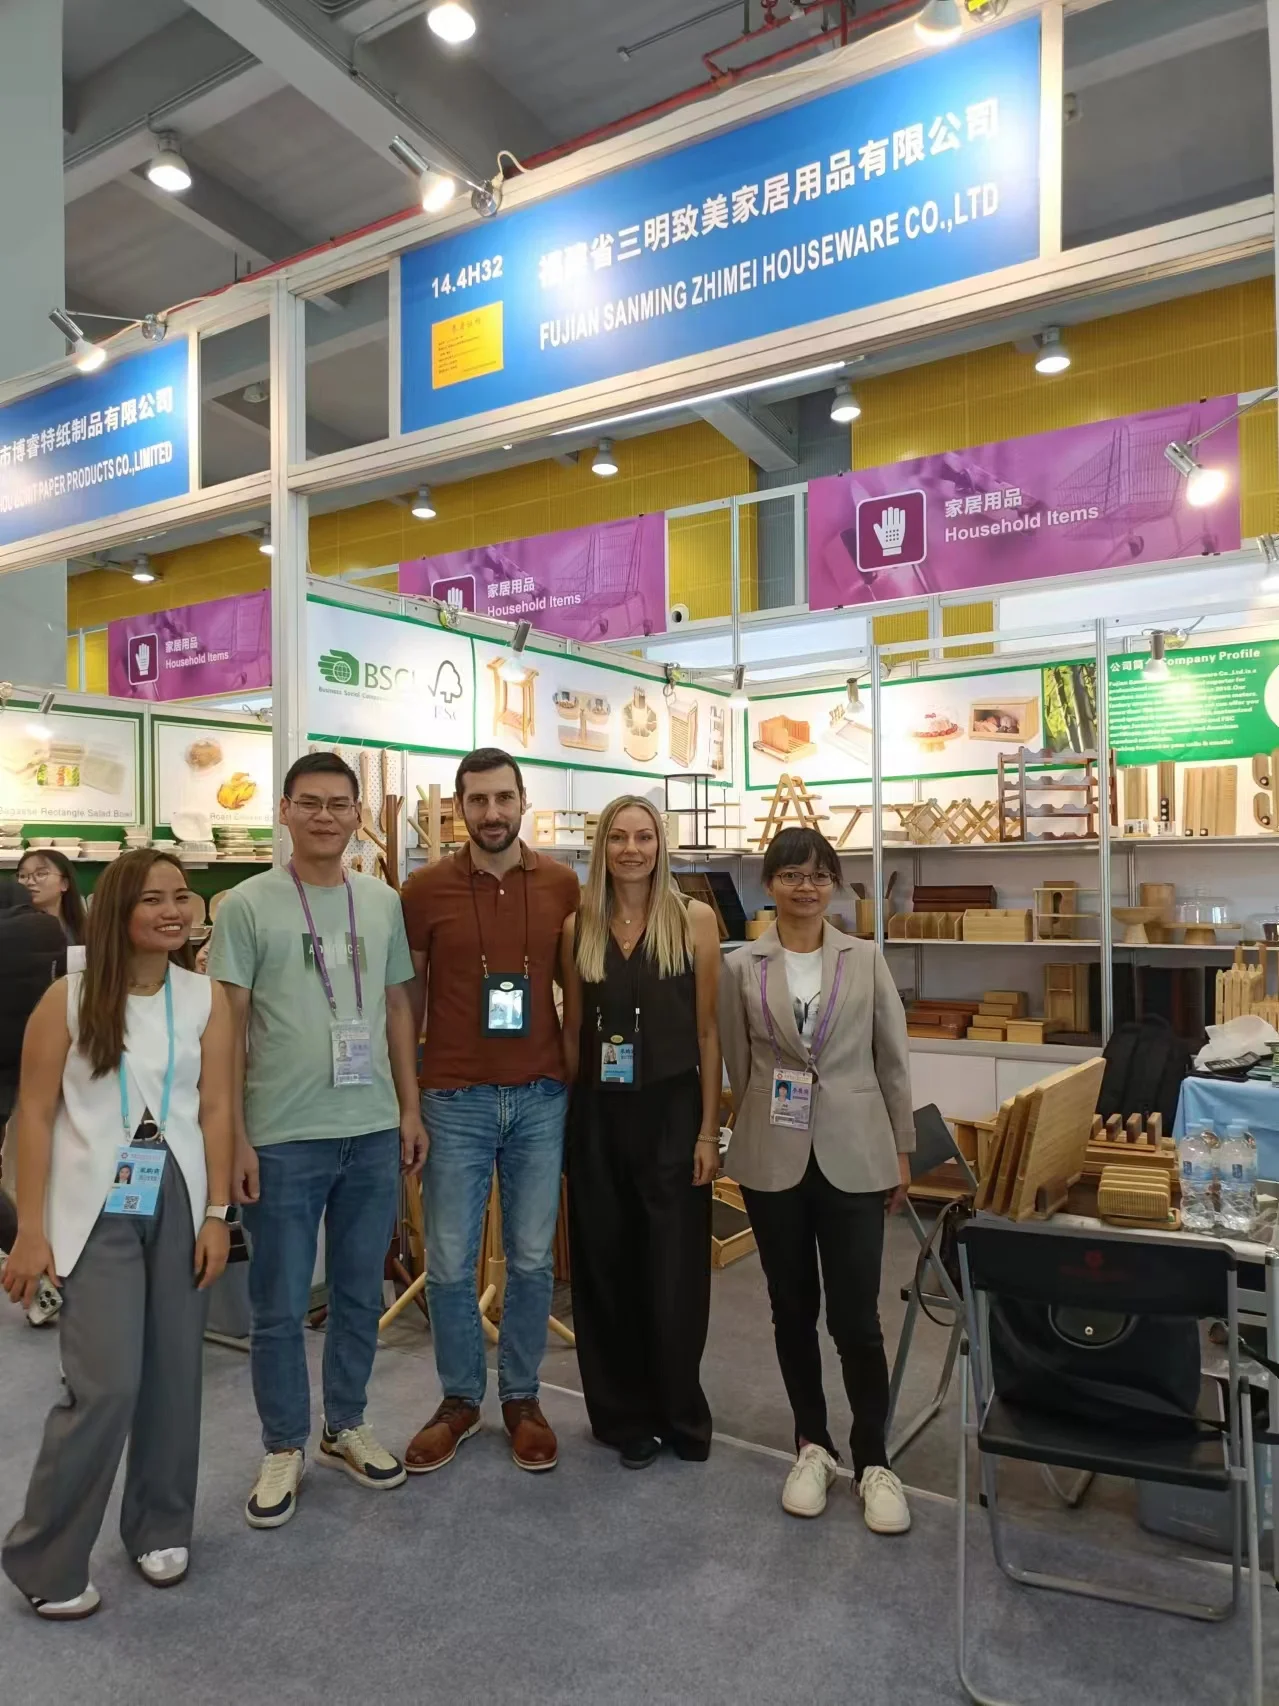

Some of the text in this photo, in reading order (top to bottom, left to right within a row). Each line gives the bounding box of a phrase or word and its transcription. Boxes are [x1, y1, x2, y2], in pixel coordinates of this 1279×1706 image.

[431, 254, 504, 298] 14.4H32
[539, 306, 599, 351] FUJIAN
[603, 280, 687, 331] SANMING
[691, 258, 757, 305] ZHIMEI
[763, 212, 899, 284] HOUSEWARE
[38, 474, 66, 501] PAPER
[66, 458, 114, 492] PRODUCTS
[944, 487, 1022, 518] 家居用品
[945, 506, 1099, 543] Household Items
[487, 576, 535, 598] 家居用品
[487, 594, 581, 617] Household Items
[165, 636, 198, 653] 家居用品
[1218, 649, 1261, 661] Profile
[165, 651, 229, 669] Household Items
[1109, 659, 1153, 672] 公司简
[318, 686, 342, 695] Business
[41, 807, 85, 818] Rectangle
[87, 808, 111, 817] Salad
[113, 809, 133, 818] Bowl
